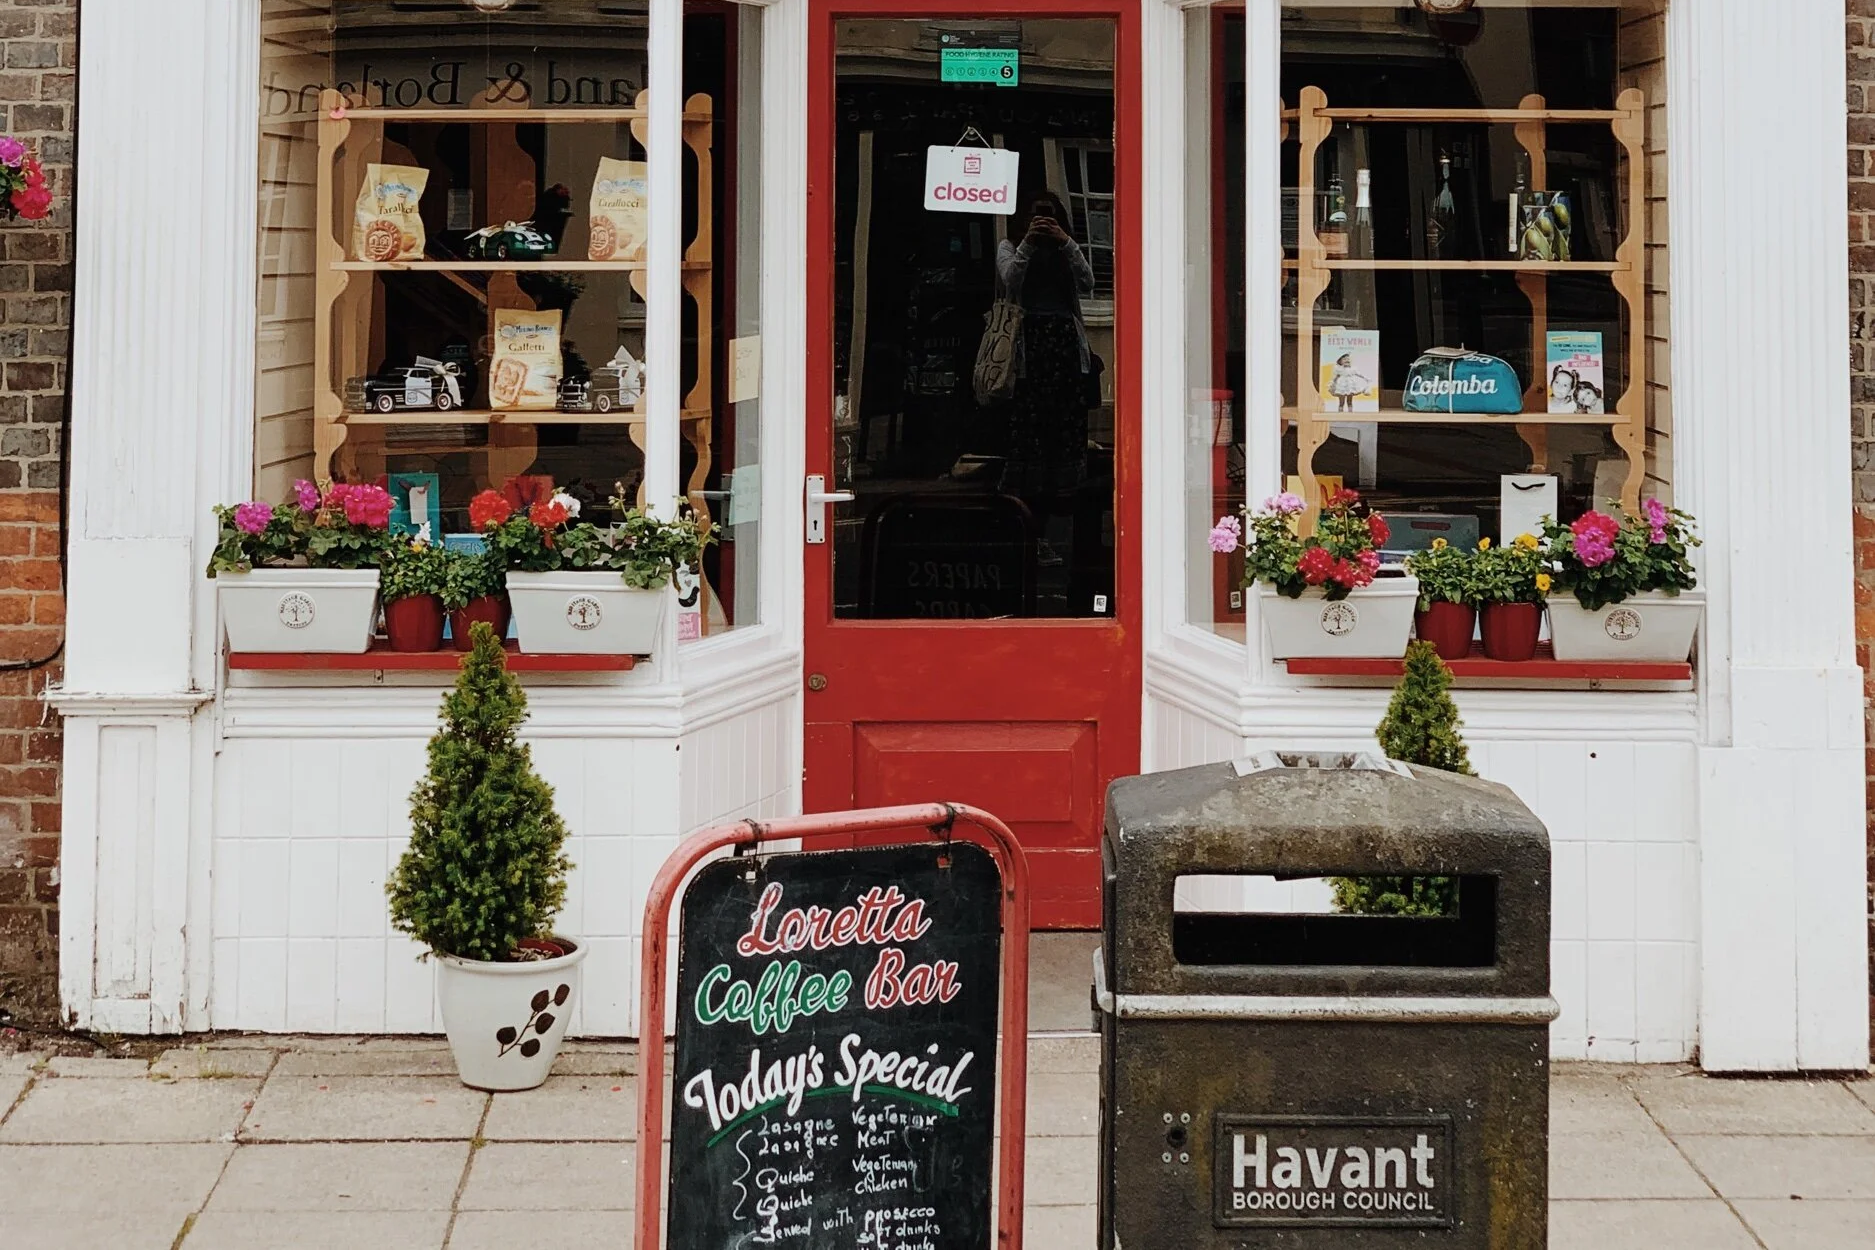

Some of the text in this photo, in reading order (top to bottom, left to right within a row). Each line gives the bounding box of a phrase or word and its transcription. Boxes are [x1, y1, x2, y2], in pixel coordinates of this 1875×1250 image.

[934, 182, 1008, 205] closed
[1410, 374, 1499, 396] Colomba
[737, 881, 932, 957] Loretta
[695, 948, 963, 1036] Coffee Bar
[684, 1033, 975, 1131] Today's Special
[1233, 1134, 1434, 1188] Havant
[1233, 1191, 1434, 1210] BOROUGH COUNCIL
